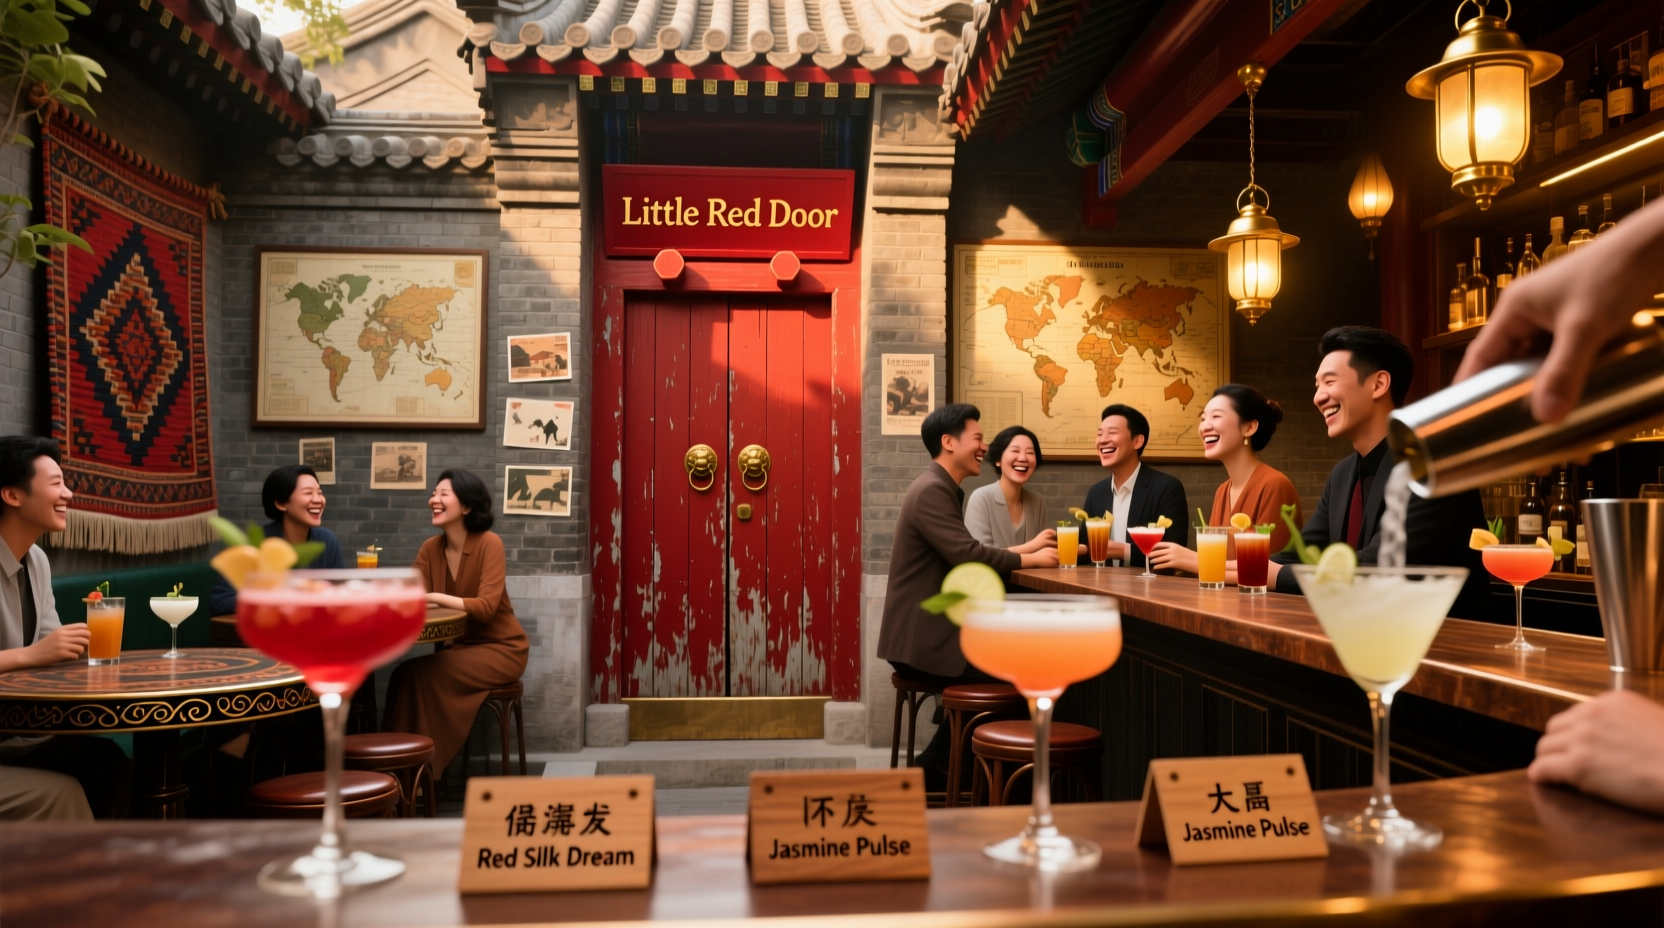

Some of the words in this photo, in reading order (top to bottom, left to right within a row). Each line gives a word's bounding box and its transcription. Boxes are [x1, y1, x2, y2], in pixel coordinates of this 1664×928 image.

[622, 196, 700, 227] Little
[706, 197, 762, 228] Red
[767, 198, 840, 229] Door
[1182, 820, 1257, 843] Jasmine
[1259, 815, 1311, 838] Pulse
[477, 847, 519, 869] Red
[567, 846, 635, 867] Dream
[768, 836, 851, 861] Jasmine
[856, 833, 912, 858] Pulse
